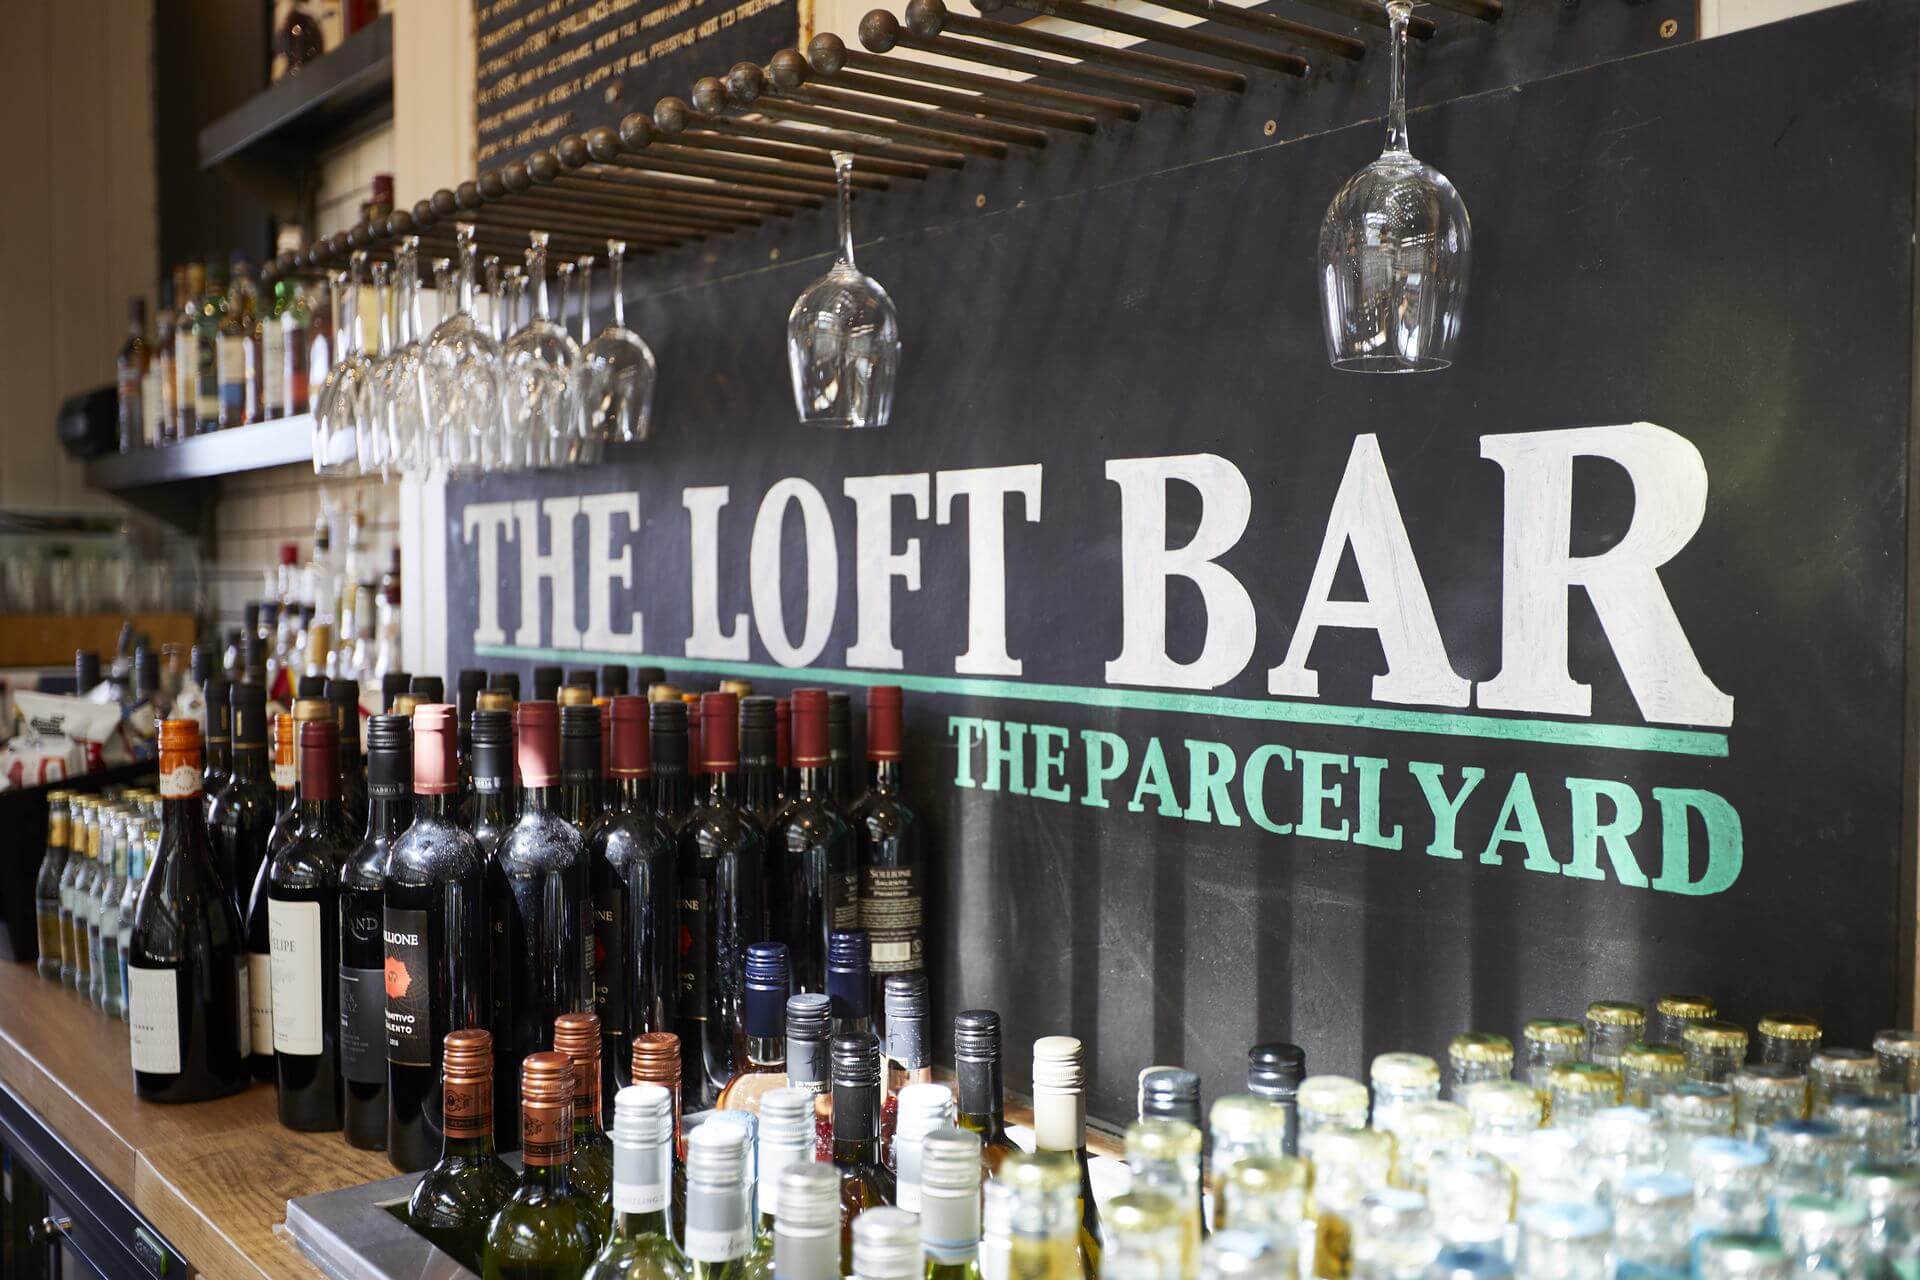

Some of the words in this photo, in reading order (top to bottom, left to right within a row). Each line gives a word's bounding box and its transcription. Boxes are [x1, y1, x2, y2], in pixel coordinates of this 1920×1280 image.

[463, 491, 644, 654] THE
[682, 464, 1043, 676] LOFT
[1105, 421, 1734, 728] BAR
[948, 716, 1070, 802] THE
[1081, 729, 1403, 849] PARCEL
[1409, 761, 1743, 896] YARD
